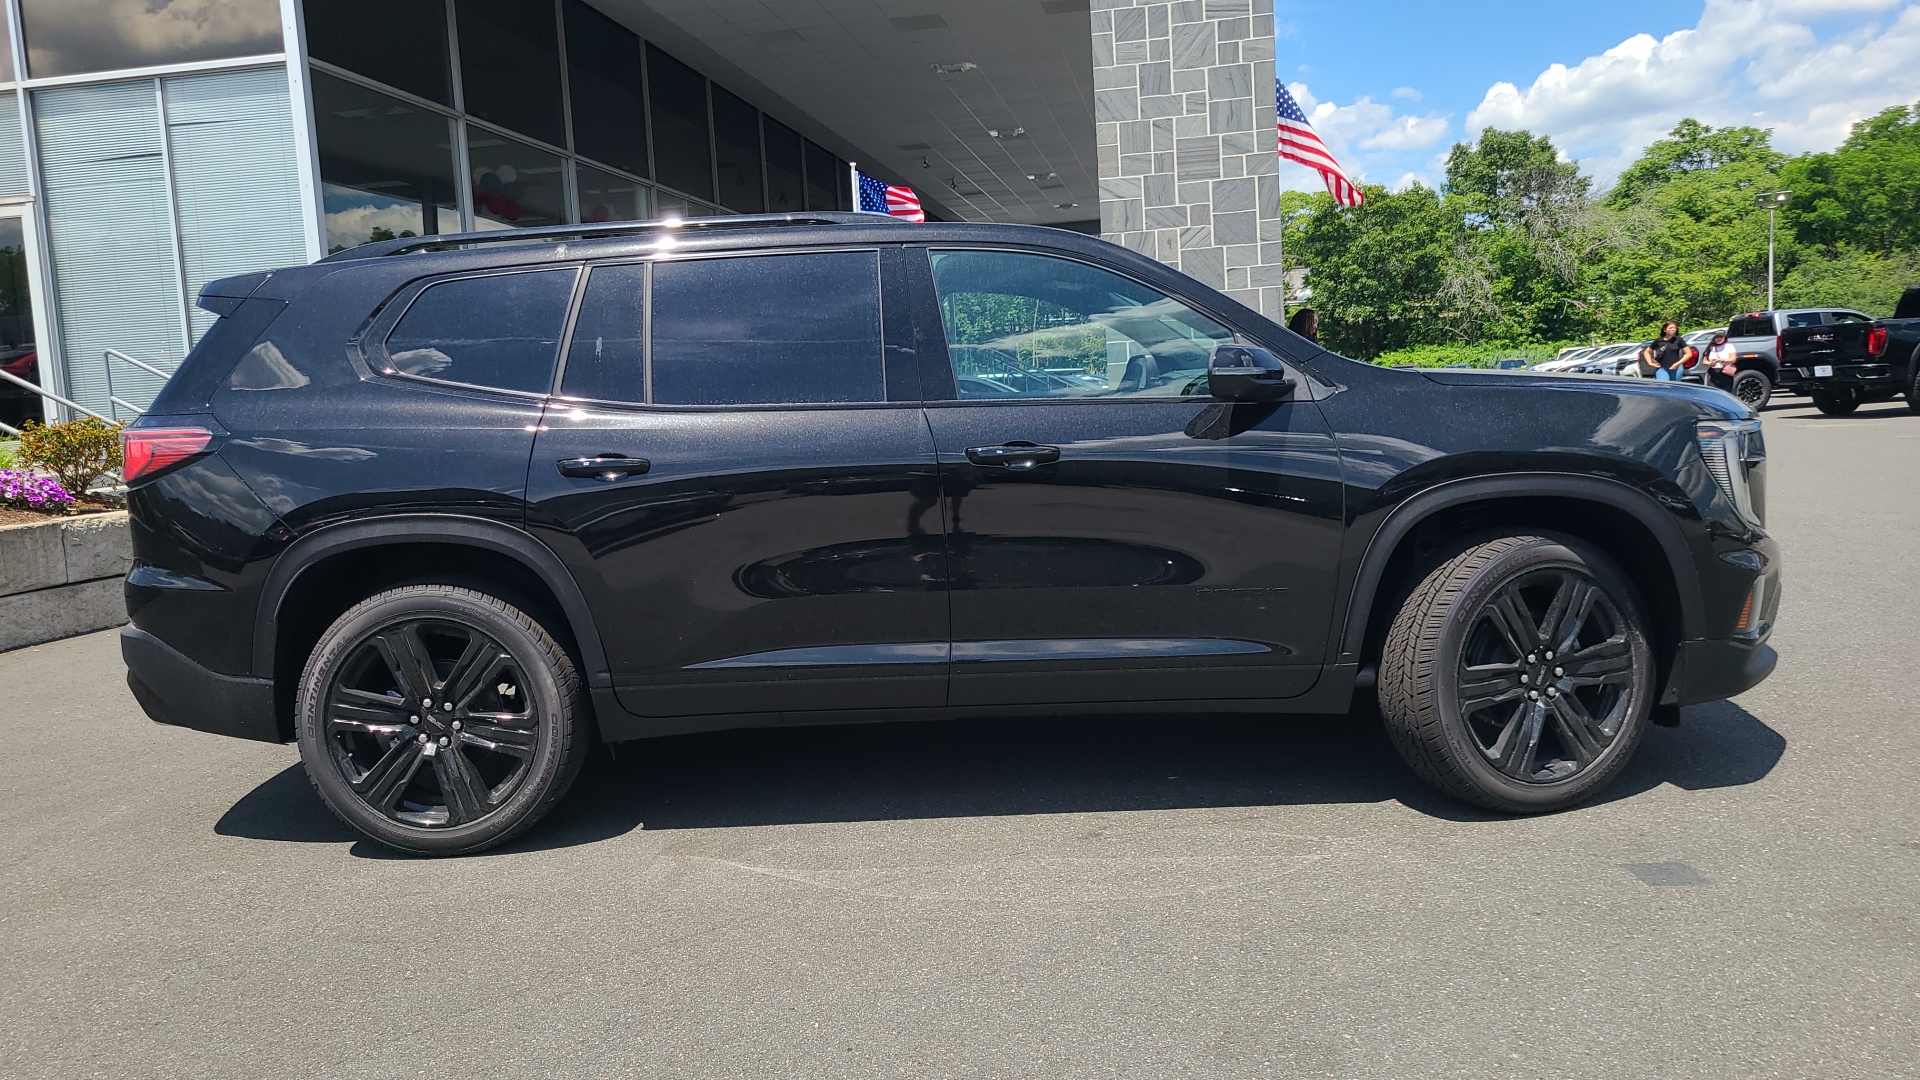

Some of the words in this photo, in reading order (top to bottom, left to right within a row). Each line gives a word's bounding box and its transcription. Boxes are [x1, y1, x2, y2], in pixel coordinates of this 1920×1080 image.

[1535, 664, 1547, 686] GMC
[308, 636, 351, 739] CONTINENTAL
[426, 714, 446, 731] GMC
